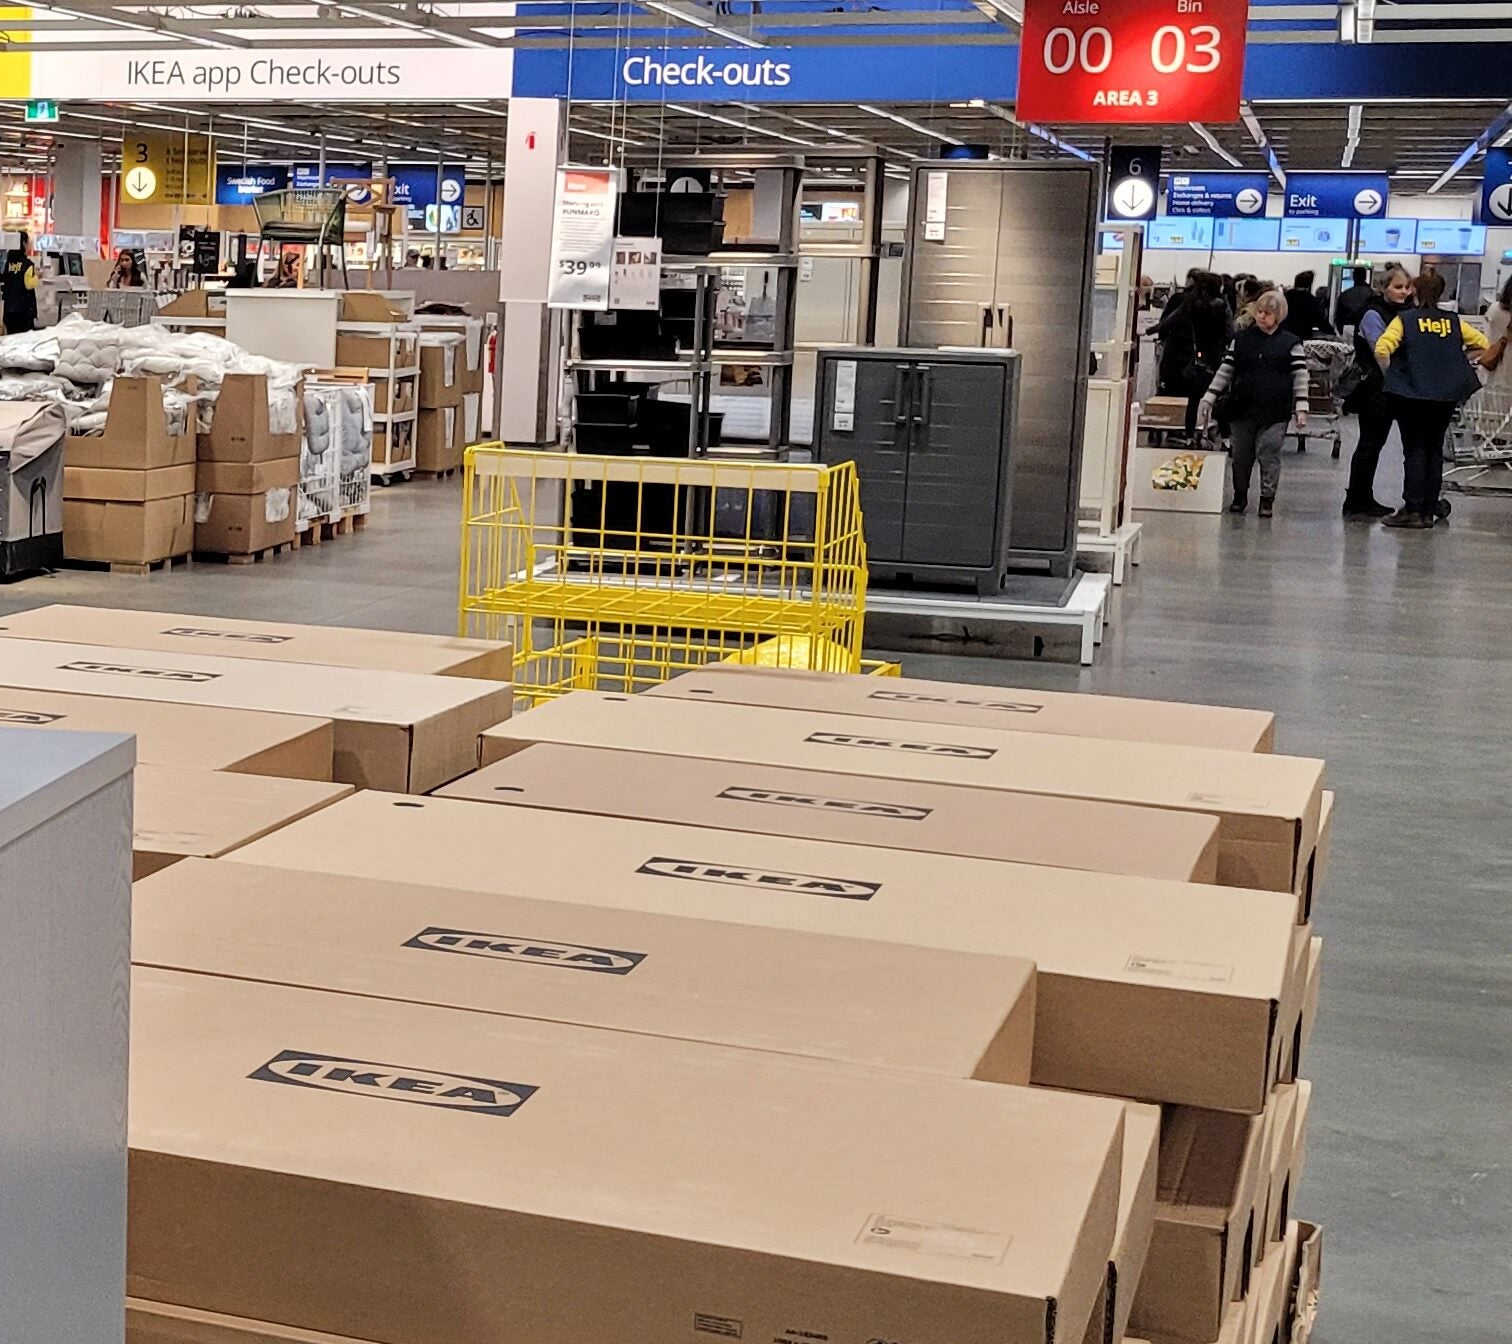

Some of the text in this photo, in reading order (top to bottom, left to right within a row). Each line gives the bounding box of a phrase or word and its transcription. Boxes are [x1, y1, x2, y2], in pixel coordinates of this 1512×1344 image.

[1062, 0, 1099, 15] Aisle
[1043, 24, 1221, 74] 00 03
[127, 58, 401, 93] IKEA app Check-outs
[622, 55, 792, 86] Check-outs
[1092, 89, 1159, 106] AREA 3
[135, 143, 148, 164] 3
[1128, 158, 1142, 175] 6
[257, 176, 276, 186] Food
[1289, 194, 1318, 208] Exit
[1417, 317, 1452, 338] Hej!
